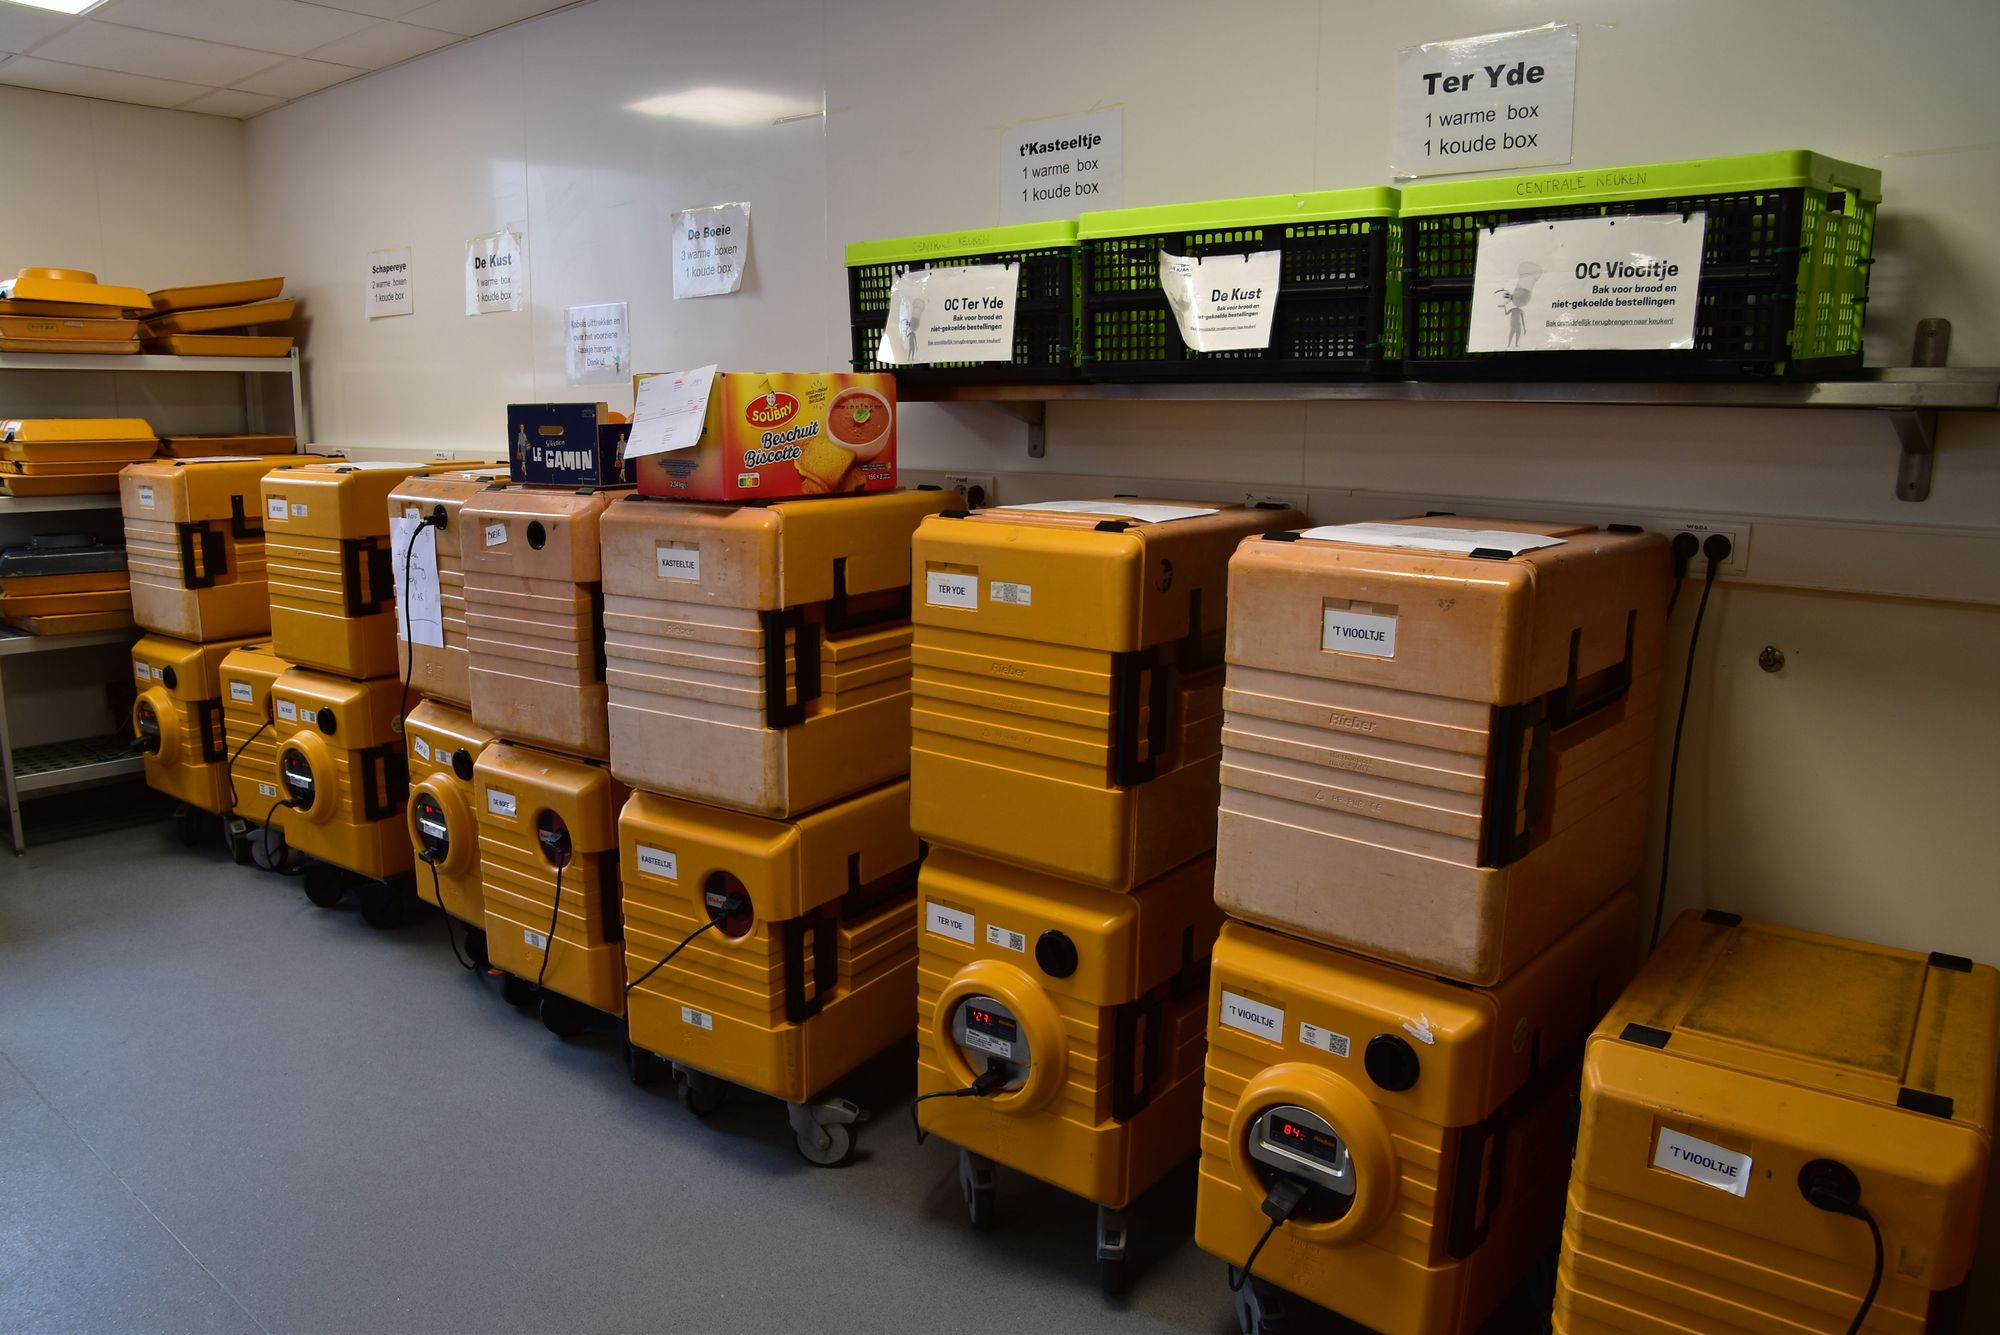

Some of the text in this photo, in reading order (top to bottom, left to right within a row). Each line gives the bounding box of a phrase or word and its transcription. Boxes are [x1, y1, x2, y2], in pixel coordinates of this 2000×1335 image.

[1423, 62, 1545, 96] Ter Yde
[1425, 104, 1539, 128] 1 warme box
[1424, 132, 1538, 156] 1 koude box
[1022, 159, 1098, 179] 1 warme box
[1022, 182, 1099, 202] 1 koude box
[1516, 172, 1647, 196] CENTRALE KEUKEN
[688, 224, 731, 241] De Boeie
[681, 244, 738, 261] 3 warme boxen
[372, 262, 407, 274] Schapereye
[475, 253, 512, 270] De Kust
[692, 265, 715, 278] koude
[717, 263, 732, 274] box
[1575, 262, 1600, 280] OC
[481, 278, 498, 287] warme
[501, 276, 512, 284] box
[1592, 284, 1677, 294] Bak voor brood en
[379, 292, 394, 302] koude
[395, 291, 405, 300] box
[481, 292, 499, 302] koude
[501, 290, 512, 300] box
[944, 296, 1004, 311] OC Ter Yde
[1211, 288, 1262, 303] De Kust
[1551, 297, 1675, 310] niet-gekoelde bestellingen
[1238, 303, 1252, 311] brood
[977, 313, 994, 321] brood
[1592, 319, 1633, 328] terugbrengen
[1648, 317, 1674, 326] keuken!
[966, 323, 1002, 332] bestellingen
[752, 402, 792, 423] SOUBRY
[761, 421, 819, 449] Beschuit
[532, 447, 593, 471] LE GAMIN
[744, 445, 801, 468] Biscotte
[662, 559, 695, 570] KASTEELTJE
[938, 584, 966, 596] TER YDE
[1332, 625, 1386, 642] 'T VIOOLTJE
[990, 661, 1028, 680] Rieber
[1329, 712, 1377, 733] Rieber
[641, 855, 672, 869] KASTEELTJE
[937, 915, 963, 930] TER YDE
[1229, 1005, 1274, 1028] 'T VIOOLTJE
[1682, 1151, 1738, 1178] VIOOLTJE
